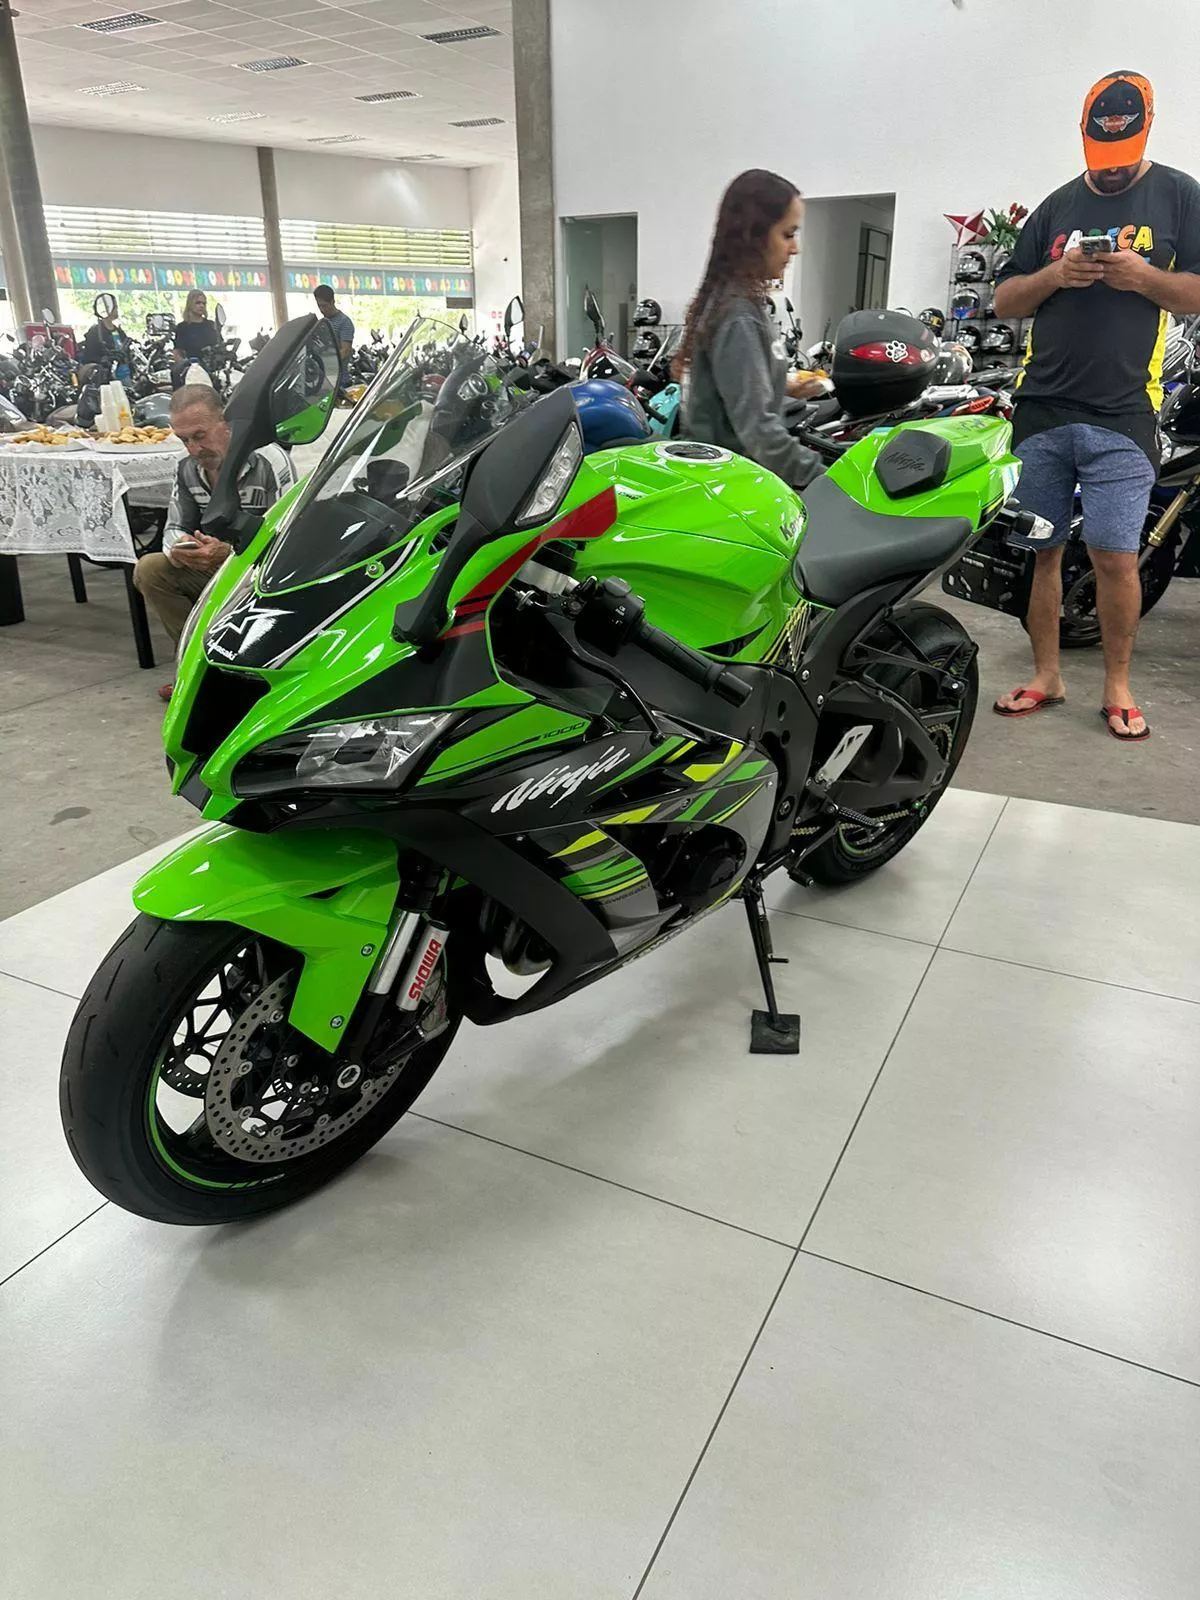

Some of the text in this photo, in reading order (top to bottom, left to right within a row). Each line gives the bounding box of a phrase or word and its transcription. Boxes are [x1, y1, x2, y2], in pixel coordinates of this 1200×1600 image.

[543, 721, 586, 739] 1000
[490, 745, 631, 813] Ninja
[408, 938, 442, 1002] SHOWA
